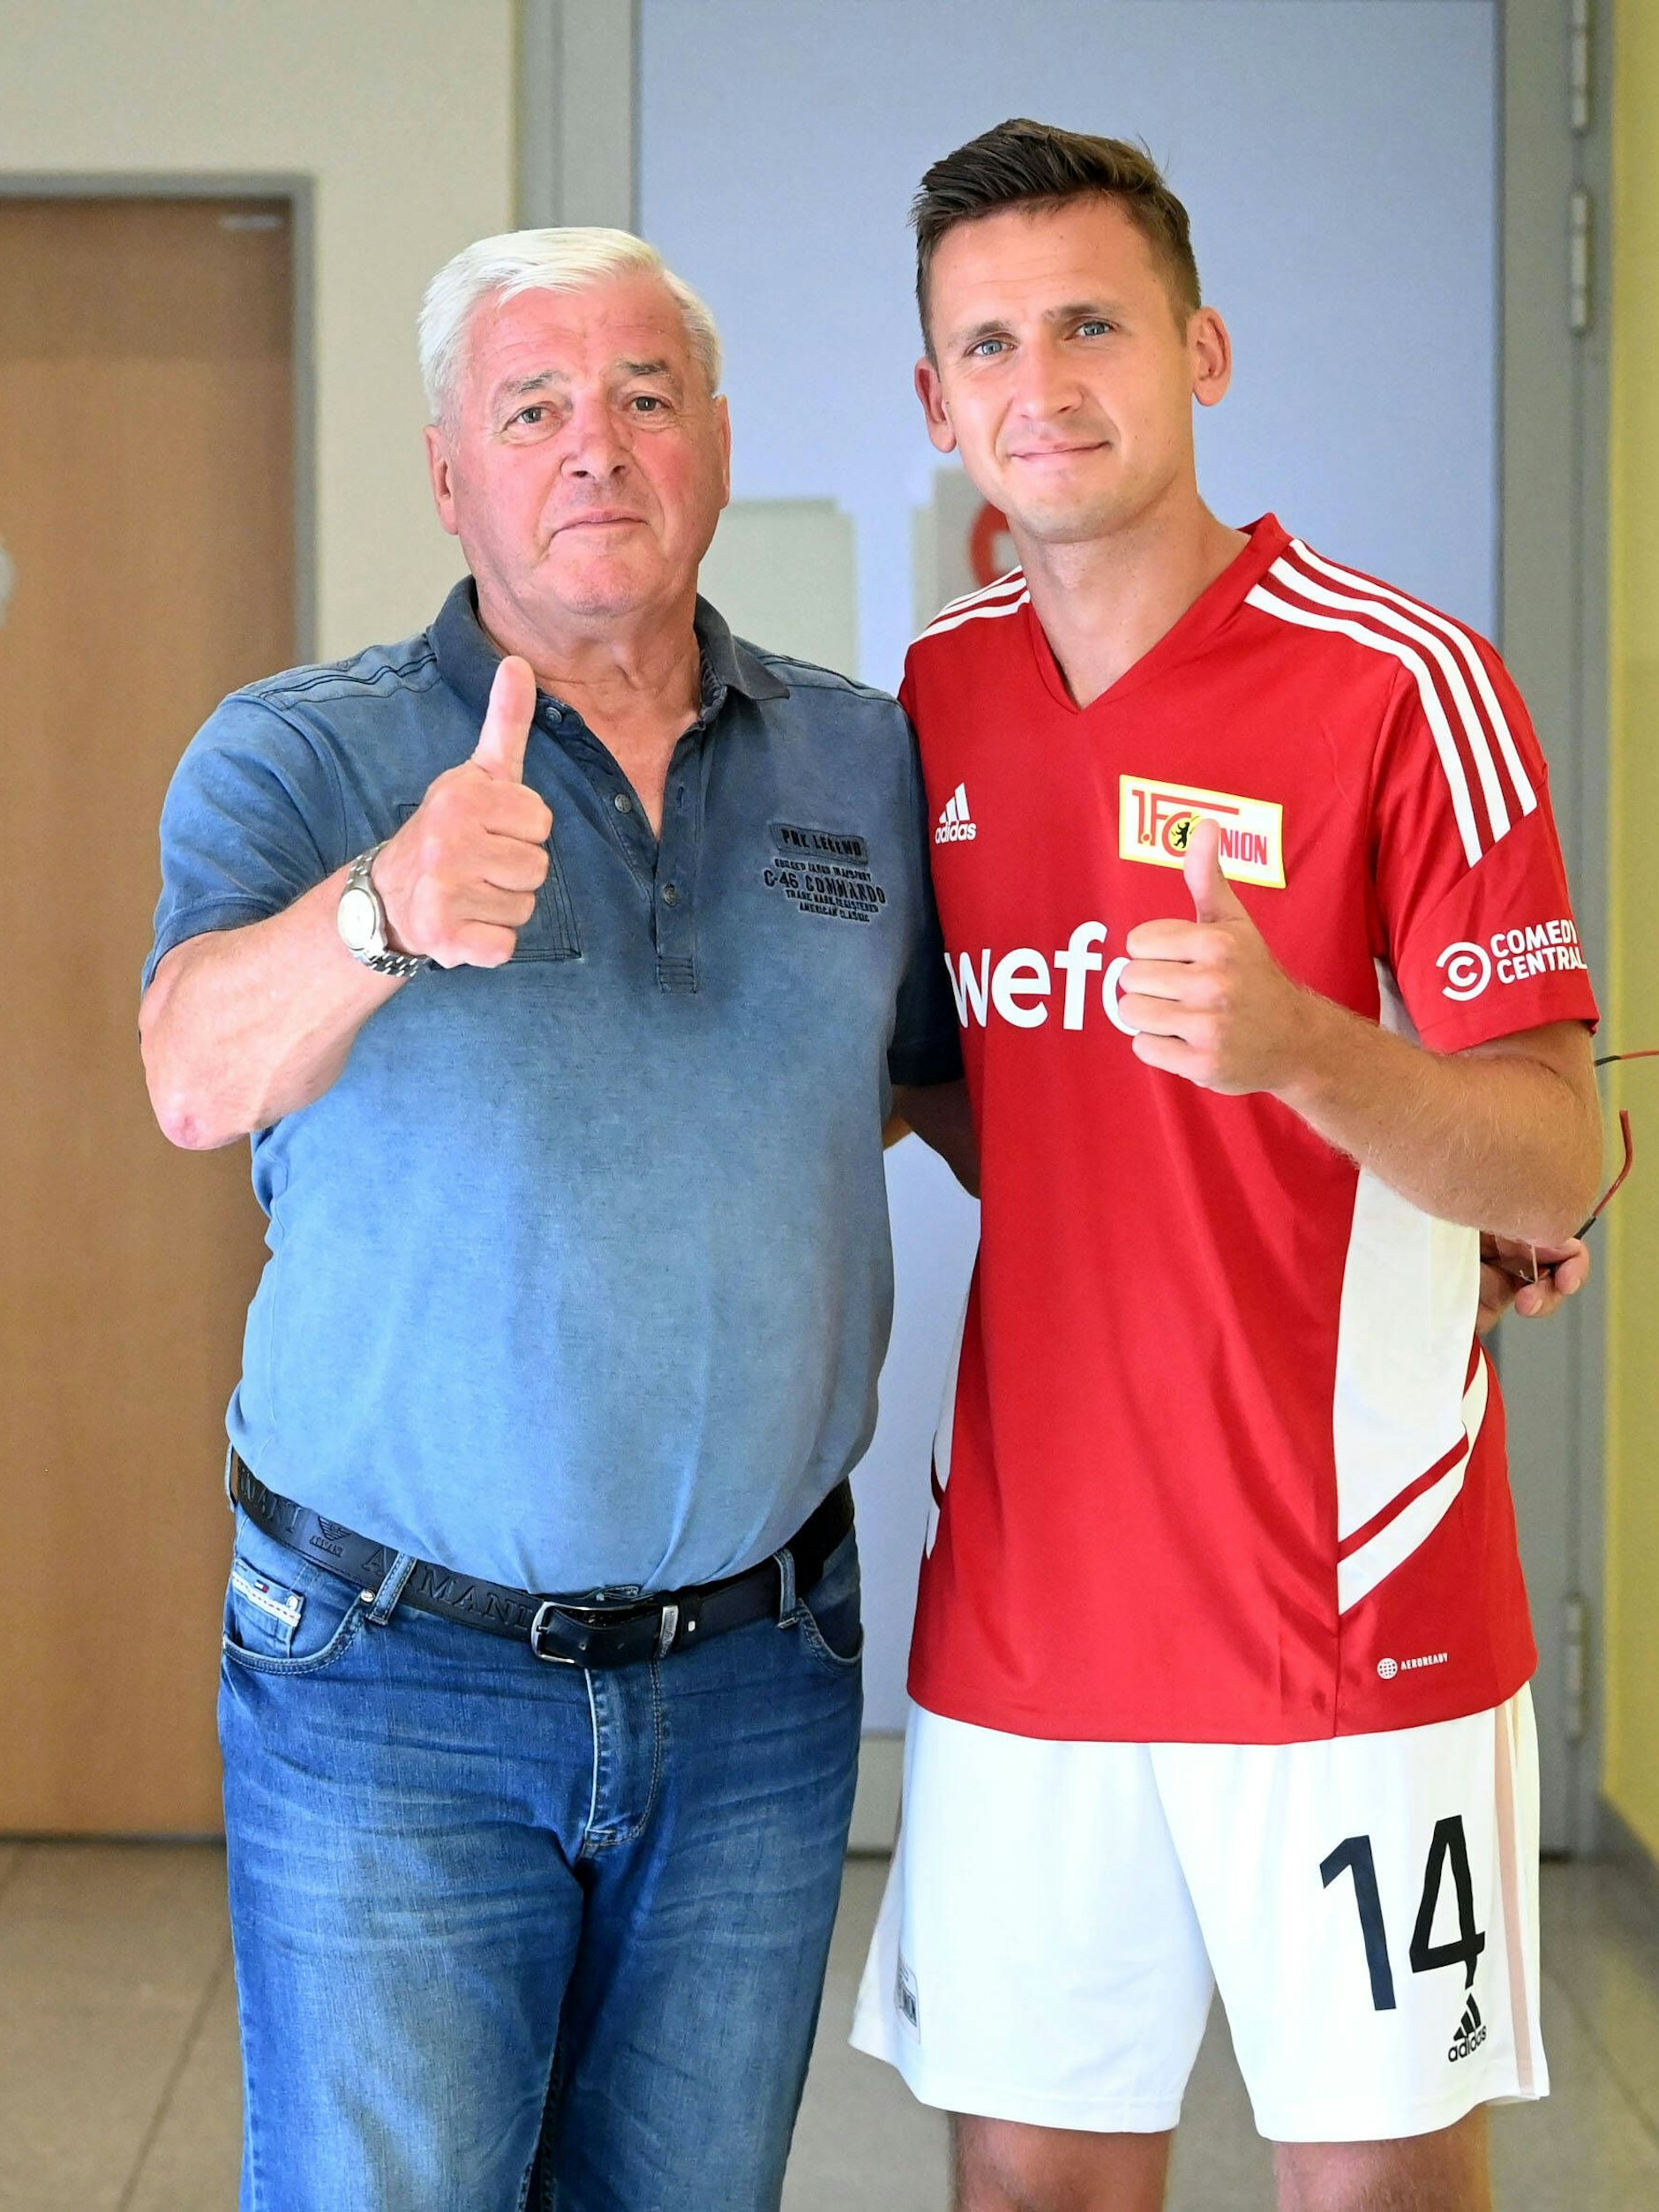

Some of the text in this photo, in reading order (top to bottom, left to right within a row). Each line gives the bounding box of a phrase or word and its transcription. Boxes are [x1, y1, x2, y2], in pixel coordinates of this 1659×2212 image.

[935, 820, 977, 844] adidas
[1220, 828, 1267, 866] NION
[763, 869, 886, 904] C-46 COMMANDO
[799, 901, 838, 918] AMERICAN
[1497, 945, 1588, 985] CENTRAL
[361, 1546, 534, 1631] AMANI
[1400, 1652, 1449, 1671] AEROREADY
[1319, 1814, 1486, 2012] 14
[1447, 2025, 1487, 2063] adidas
